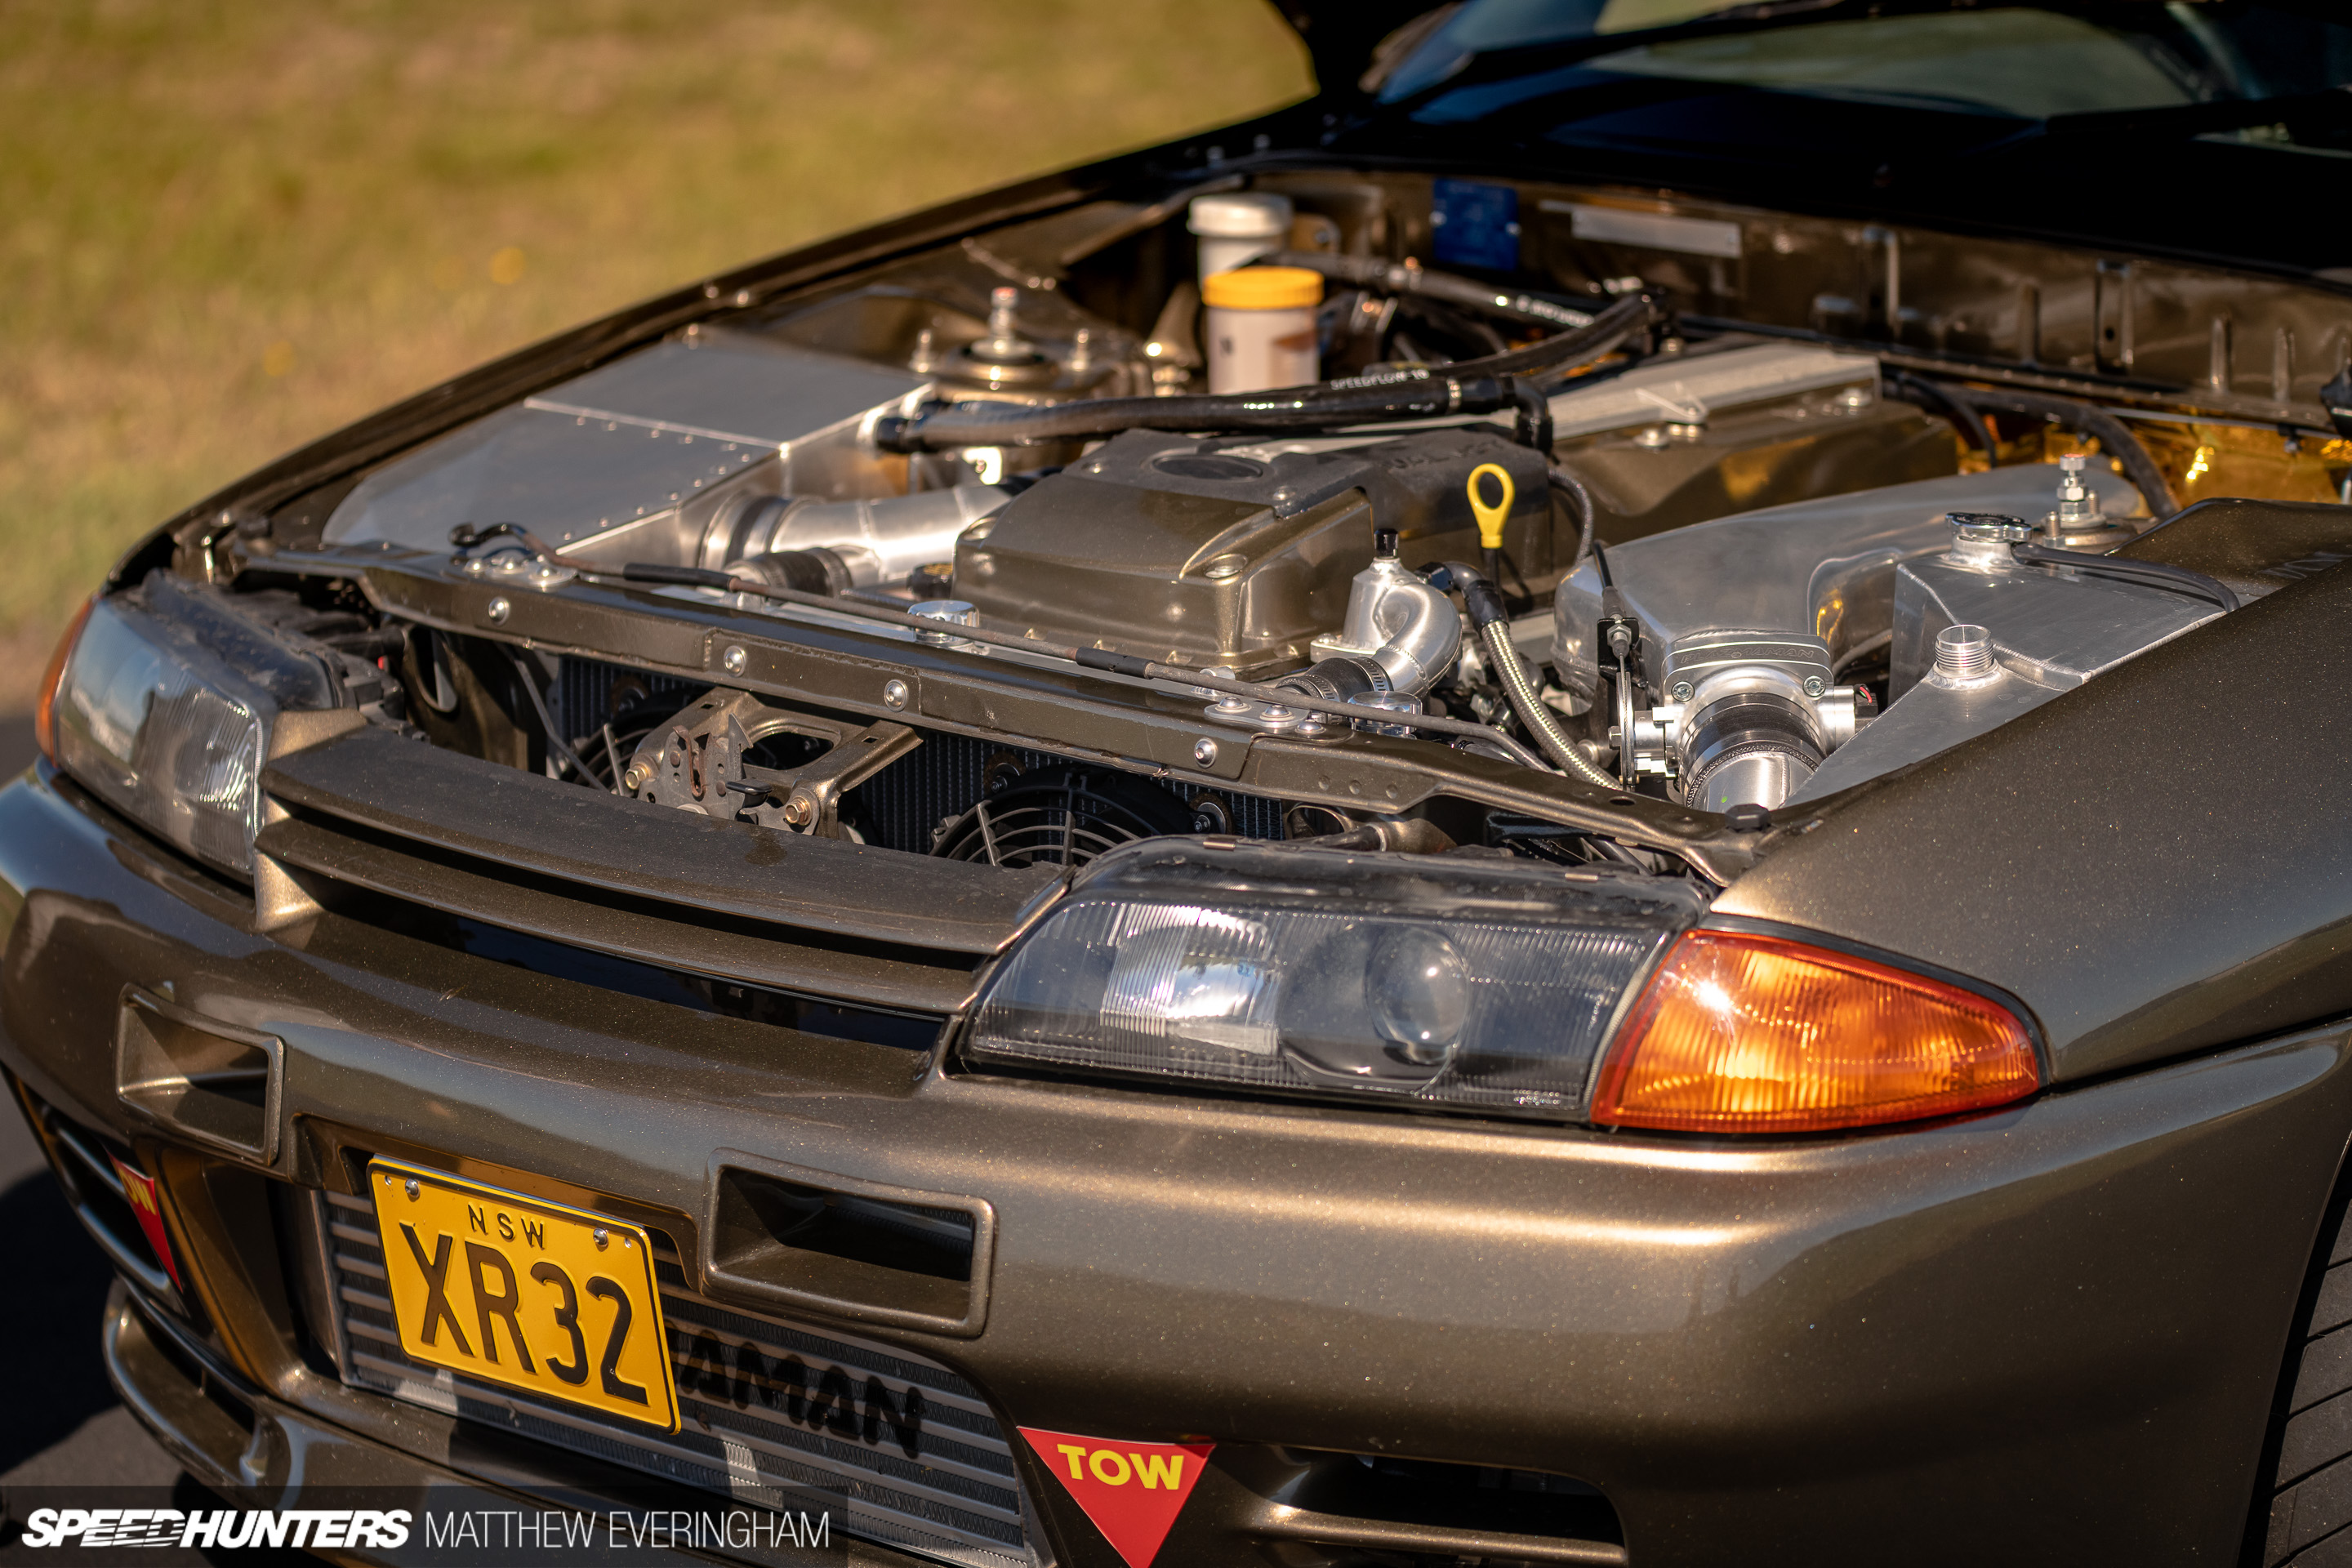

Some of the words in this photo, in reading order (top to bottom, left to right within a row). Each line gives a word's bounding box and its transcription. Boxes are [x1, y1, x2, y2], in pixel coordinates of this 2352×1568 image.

[467, 1203, 546, 1250] NSW
[399, 1222, 650, 1407] XR32
[1057, 1443, 1184, 1490] TOW
